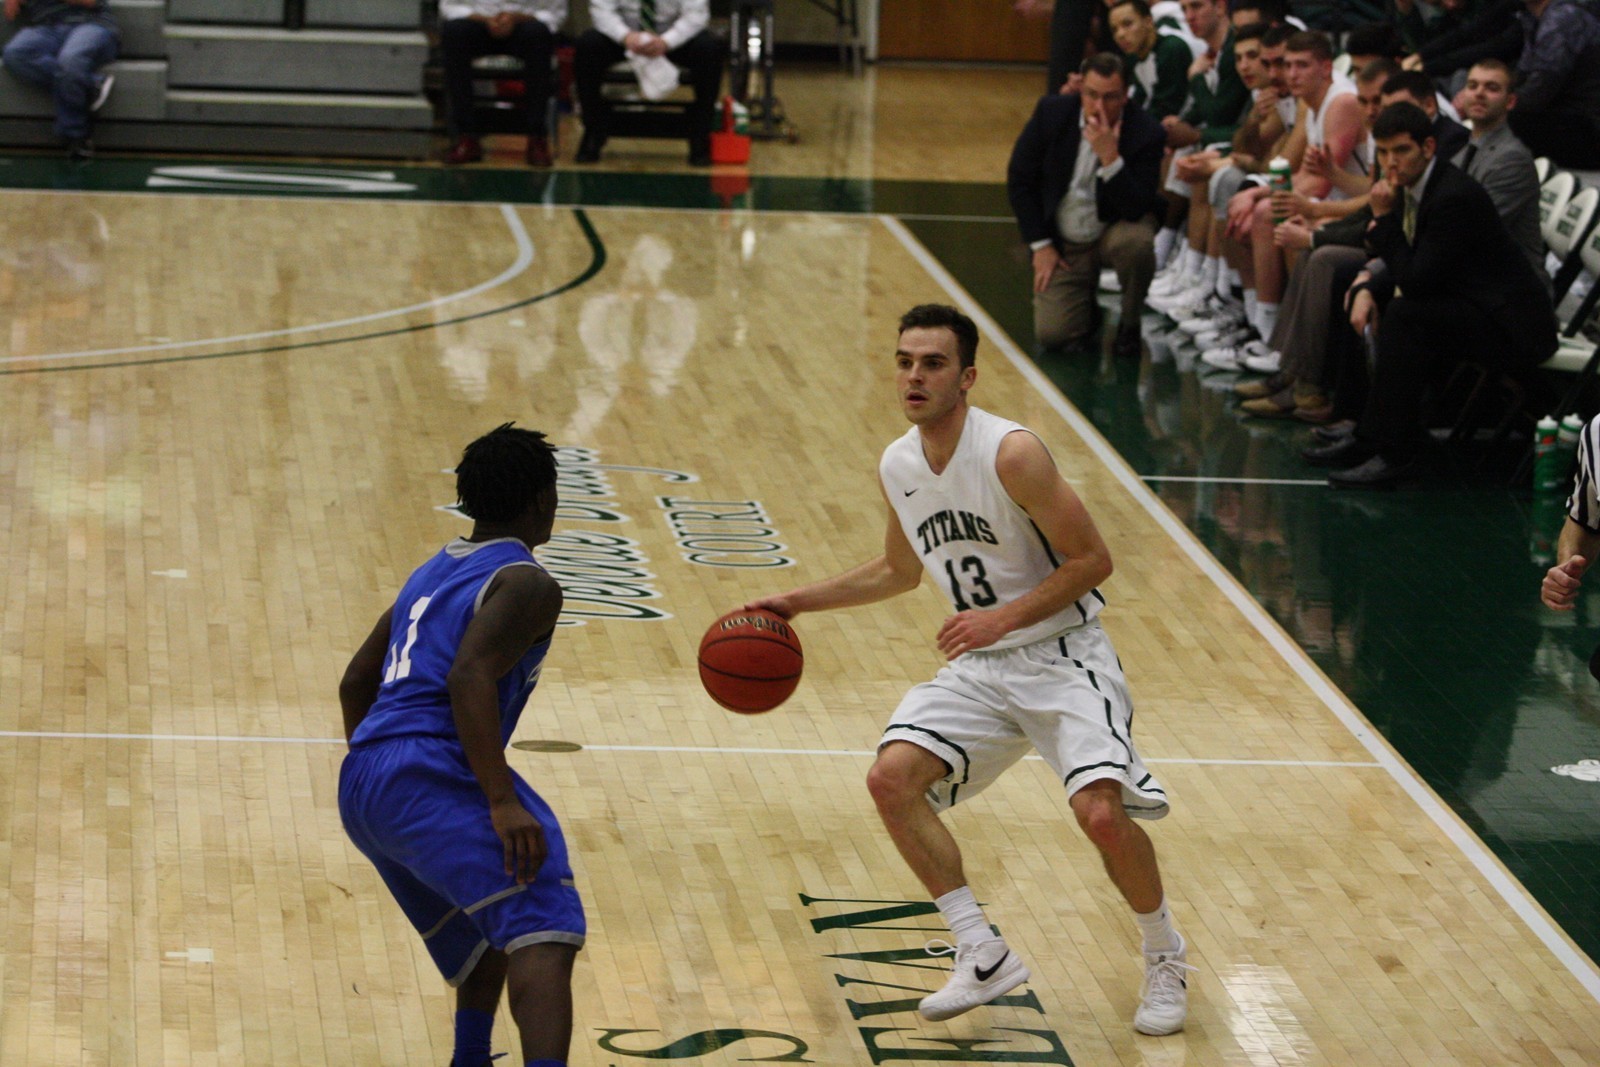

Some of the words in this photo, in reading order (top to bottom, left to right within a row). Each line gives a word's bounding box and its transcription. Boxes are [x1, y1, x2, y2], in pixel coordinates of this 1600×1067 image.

[655, 496, 796, 568] COURT
[917, 509, 999, 555] TITANS
[945, 555, 998, 612] 13
